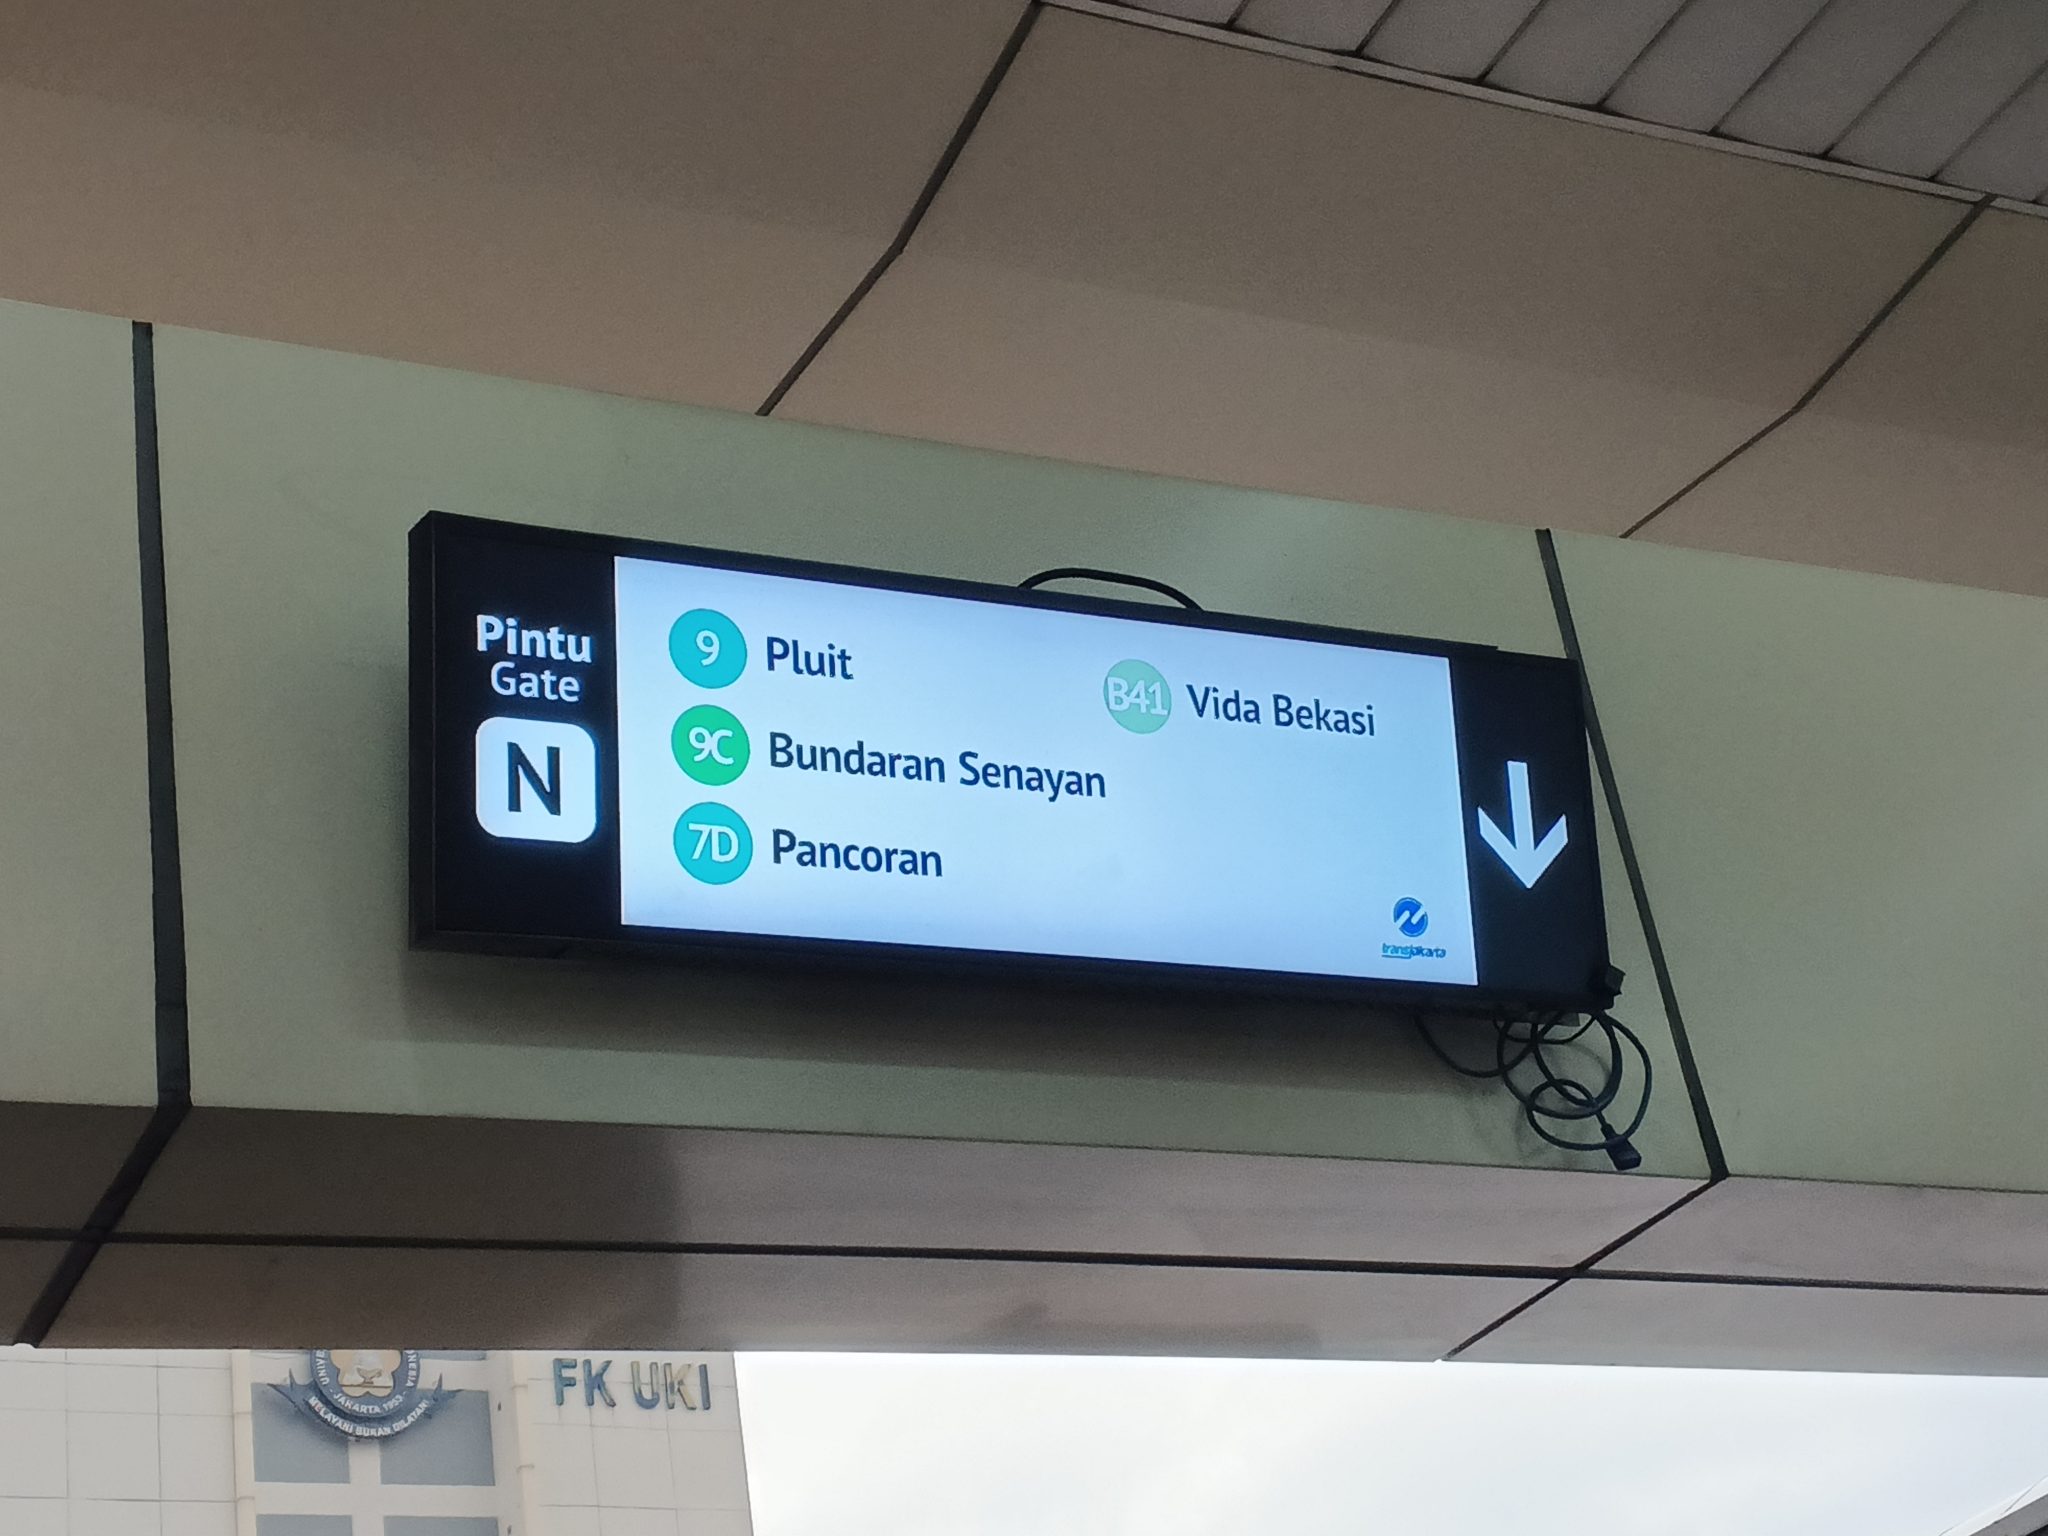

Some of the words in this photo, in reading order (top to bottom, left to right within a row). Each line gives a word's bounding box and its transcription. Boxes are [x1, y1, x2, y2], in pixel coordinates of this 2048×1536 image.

[476, 614, 592, 663] Pintu
[695, 630, 720, 666] 9
[766, 637, 854, 680] Pluit
[490, 661, 580, 702] Gate
[1107, 675, 1168, 717] B41
[1187, 684, 1261, 725] Vida
[1273, 694, 1375, 737] Bekasi
[688, 727, 734, 765] 9C
[770, 732, 945, 783] Bundaran
[959, 751, 1106, 803] Senayan
[507, 741, 561, 816] N
[687, 822, 739, 863] 7D
[772, 828, 943, 877] Pancoran
[333, 1393, 381, 1415] JAKARTA
[553, 1358, 616, 1408] FK
[631, 1360, 711, 1411] UKI
